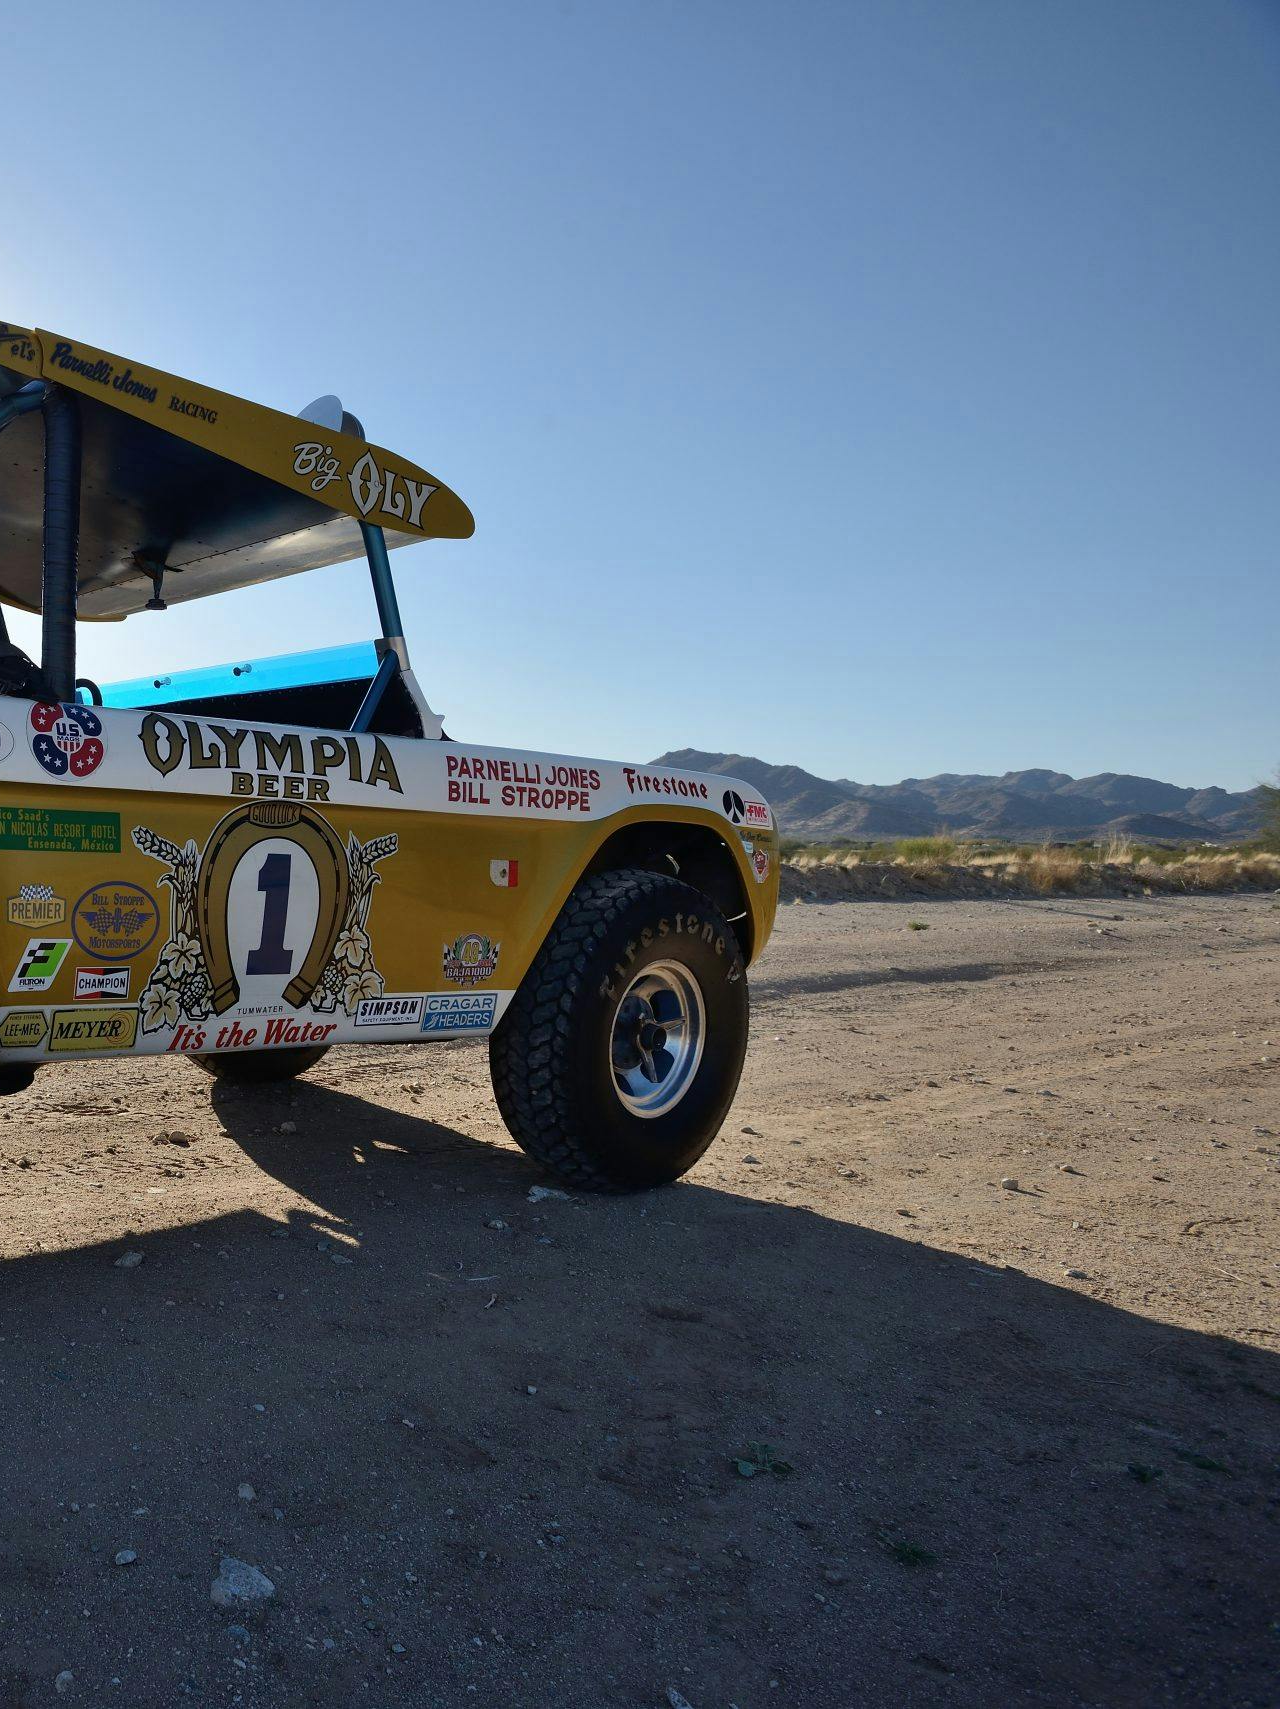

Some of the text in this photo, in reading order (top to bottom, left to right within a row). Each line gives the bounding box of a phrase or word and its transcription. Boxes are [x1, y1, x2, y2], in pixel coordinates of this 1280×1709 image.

[50, 342, 218, 424] Parnelli Jones RACING
[293, 441, 440, 530] Big OLY
[55, 722, 82, 738] U.S.
[138, 712, 404, 795] OLYMPIA
[446, 755, 601, 791] PARNELLI JONES
[230, 771, 330, 802] BEER
[623, 767, 708, 800] Firestone
[448, 780, 590, 812] BILL STROPPE
[18, 808, 50, 822] Saad's
[11, 821, 48, 837] NICOLAS
[53, 823, 86, 838] RESORT
[91, 824, 117, 839] HOTEL
[28, 837, 76, 851] Ensenada,
[11, 902, 62, 920] PREMIER
[245, 853, 292, 976] 1
[447, 967, 471, 977] BAJA
[78, 977, 126, 989] CHAMPION
[237, 1005, 284, 1015] TUMWATER
[360, 1000, 418, 1016] SIMPSON
[428, 998, 493, 1011] CRAGAR
[438, 1012, 490, 1027] HEADERS
[4, 1023, 41, 1037] LEE-MFG.
[54, 1020, 121, 1040] MEYER
[165, 1018, 337, 1051] It's the Water
